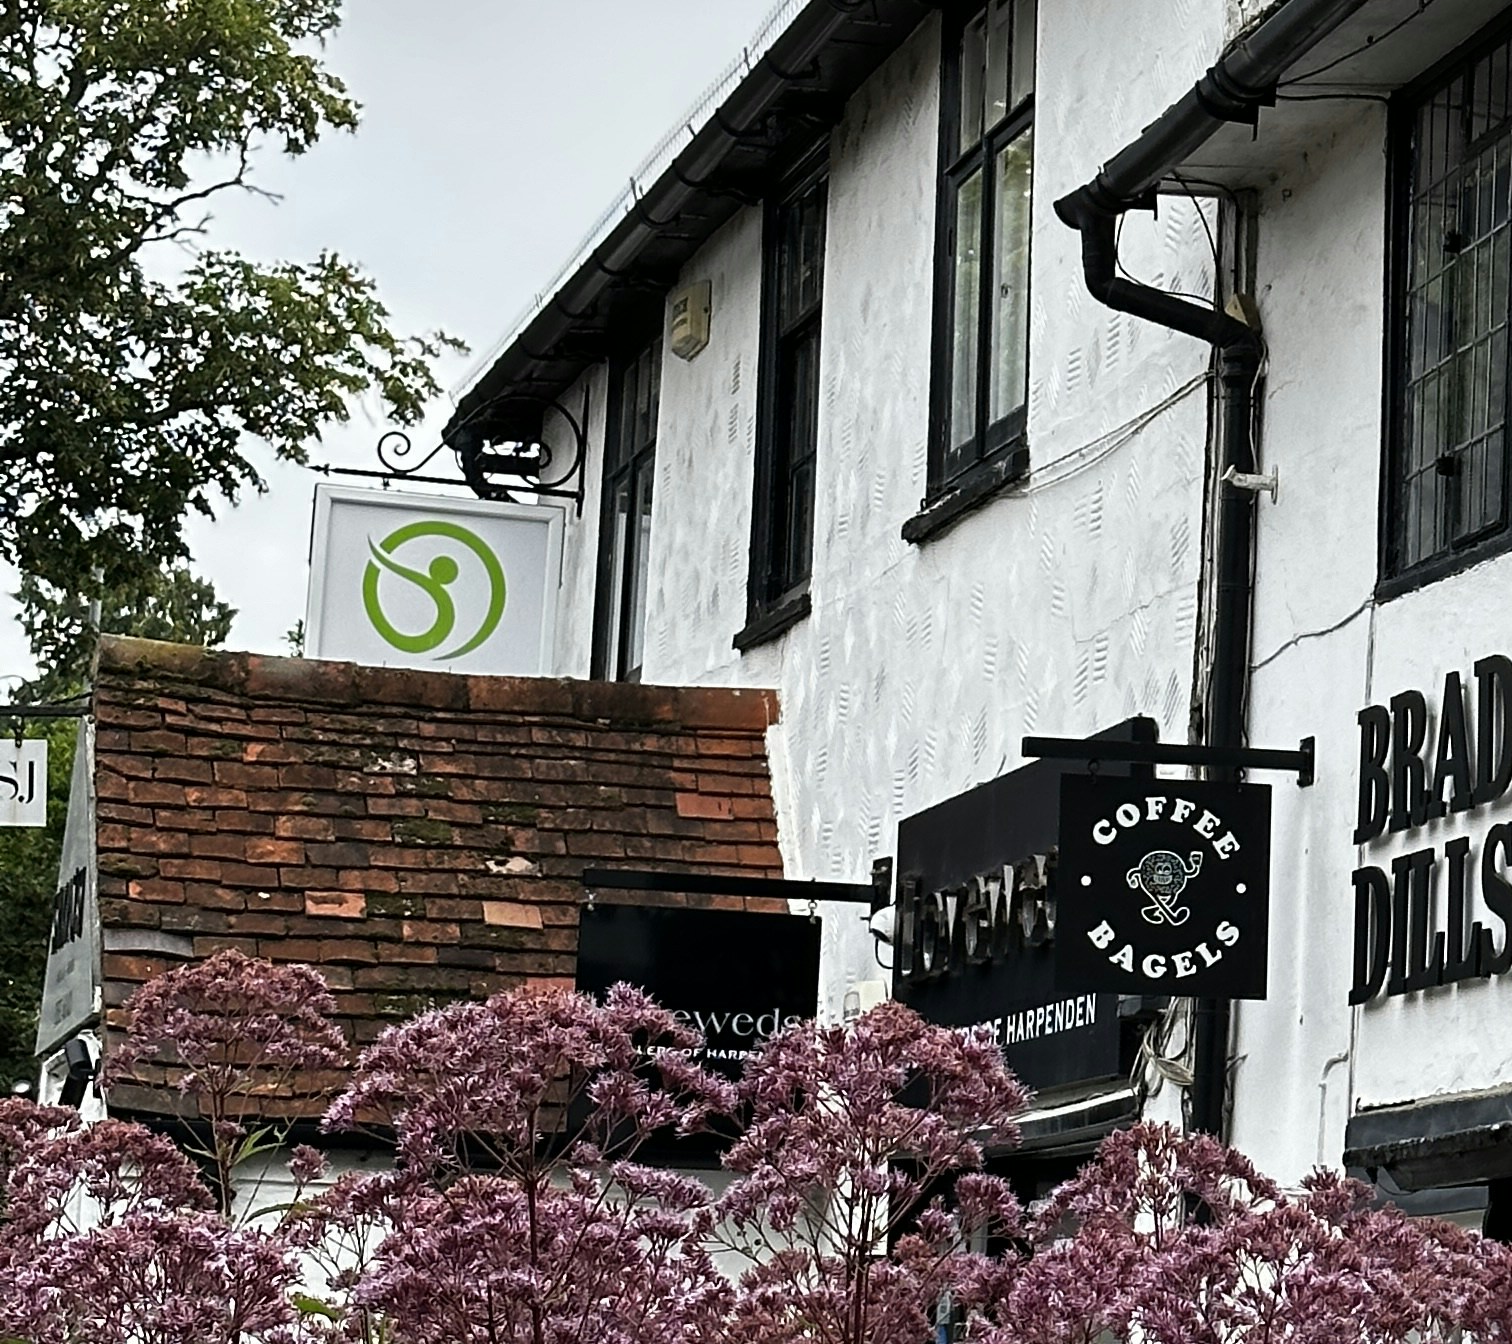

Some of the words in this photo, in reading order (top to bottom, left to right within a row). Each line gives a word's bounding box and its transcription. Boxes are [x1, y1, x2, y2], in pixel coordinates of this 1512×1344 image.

[1092, 796, 1241, 860] COFFEE
[1087, 919, 1240, 979] BAGELS
[1006, 993, 1096, 1046] HARPENDEN
